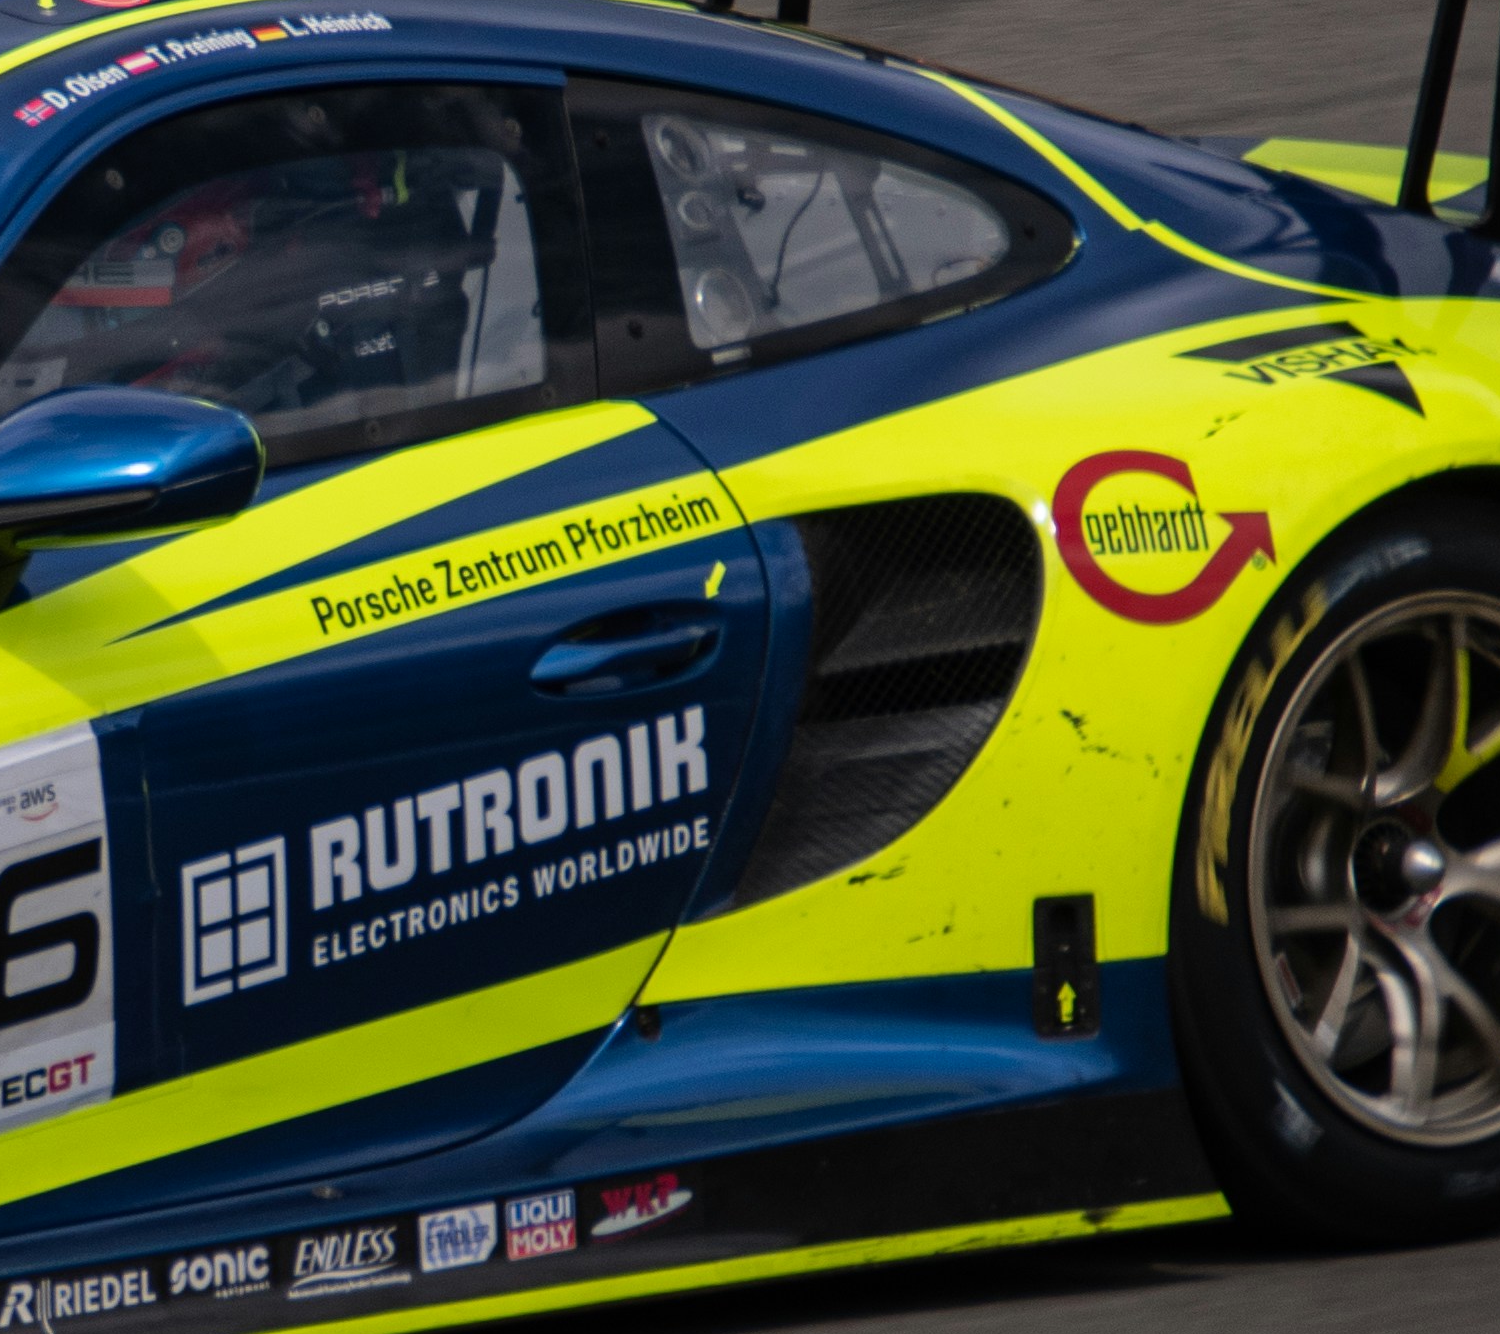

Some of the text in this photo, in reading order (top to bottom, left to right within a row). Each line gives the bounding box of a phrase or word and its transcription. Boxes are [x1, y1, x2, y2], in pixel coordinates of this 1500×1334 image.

[64, 64, 129, 99] Olsen
[1086, 501, 1211, 556] gebhardt
[310, 492, 720, 635] Porsche Zentrum Pforzheim
[20, 783, 57, 810] aws
[310, 704, 709, 911] RUTRONIK
[312, 817, 710, 967] ELECTRONICS WORLDWIDE
[511, 1194, 572, 1228] LIQUI
[294, 1225, 398, 1277] ENDLESS
[512, 1222, 575, 1256] MOLY
[54, 1269, 157, 1318] RIEDEL
